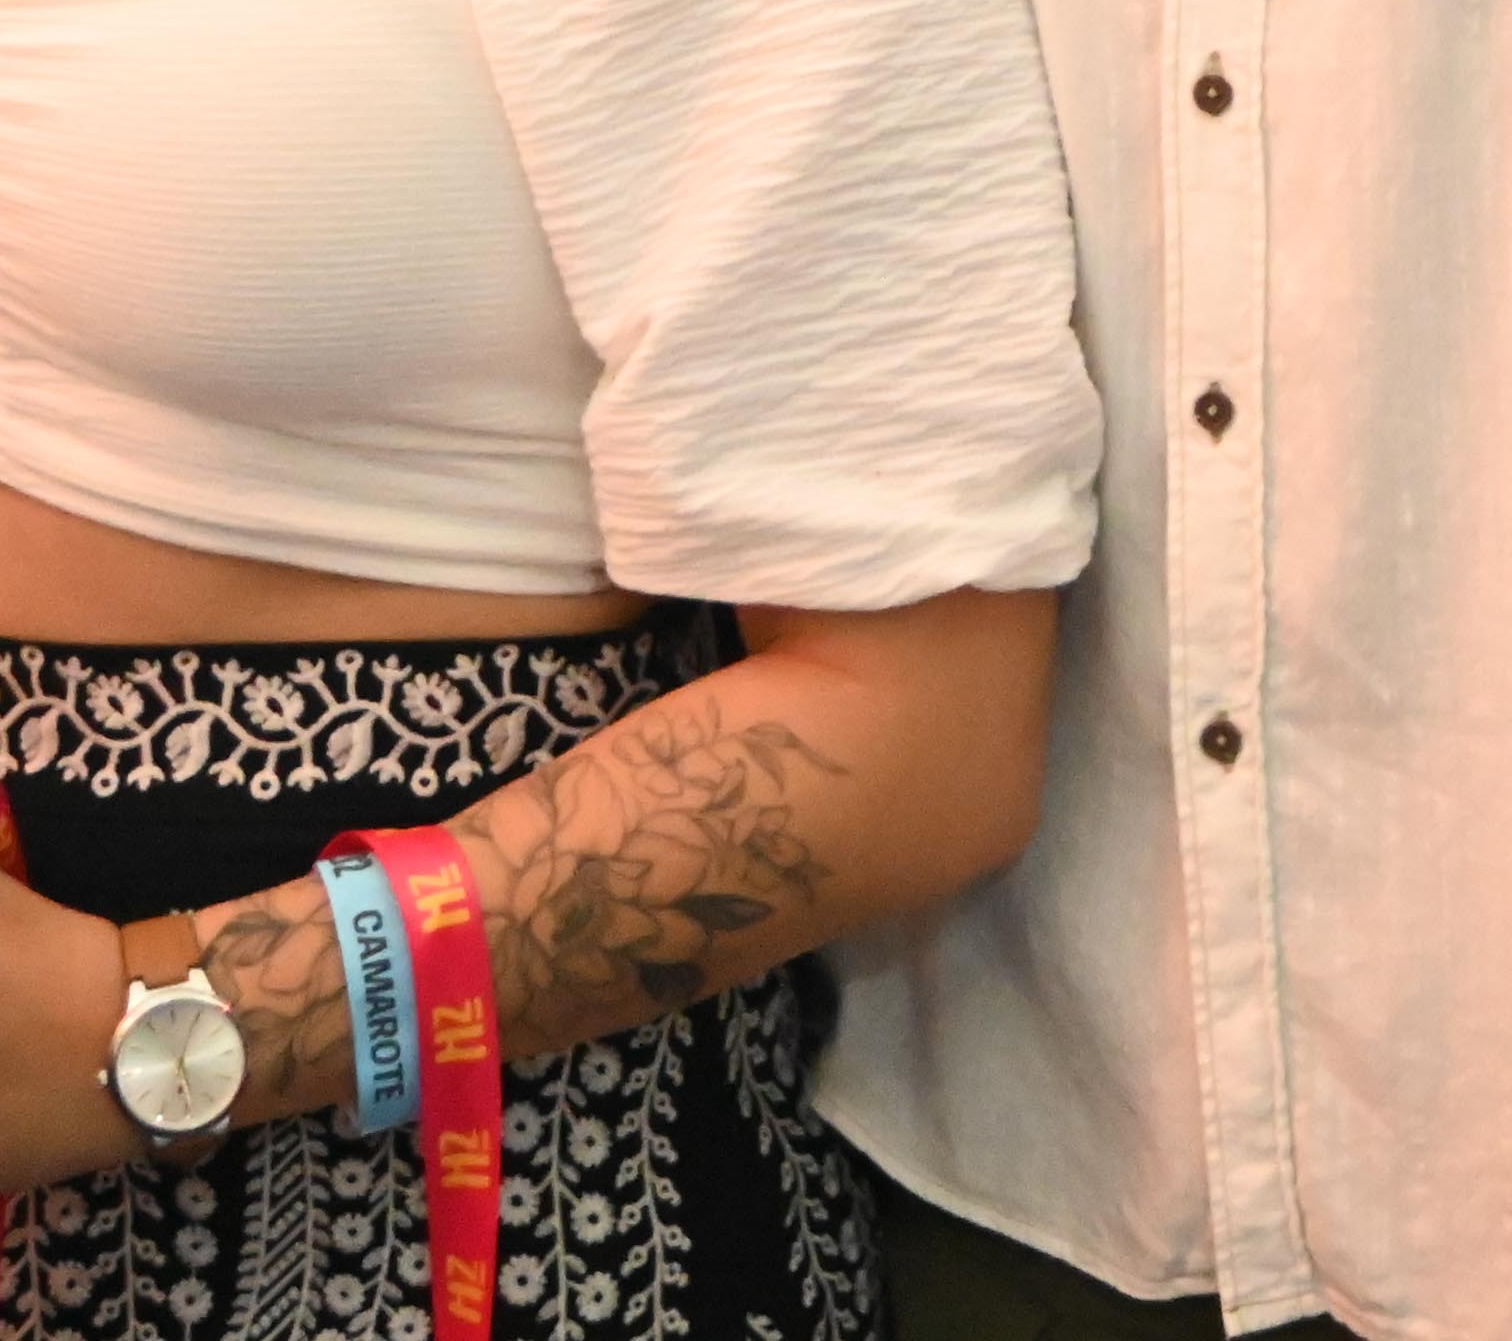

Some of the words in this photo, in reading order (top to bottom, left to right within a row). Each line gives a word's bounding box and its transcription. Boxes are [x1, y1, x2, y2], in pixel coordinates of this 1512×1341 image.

[408, 862, 471, 934] HZ
[352, 908, 405, 1104] CAMAROTE
[432, 995, 488, 1064] HZ
[440, 1128, 492, 1188] HZ
[445, 1253, 487, 1325] HZ
